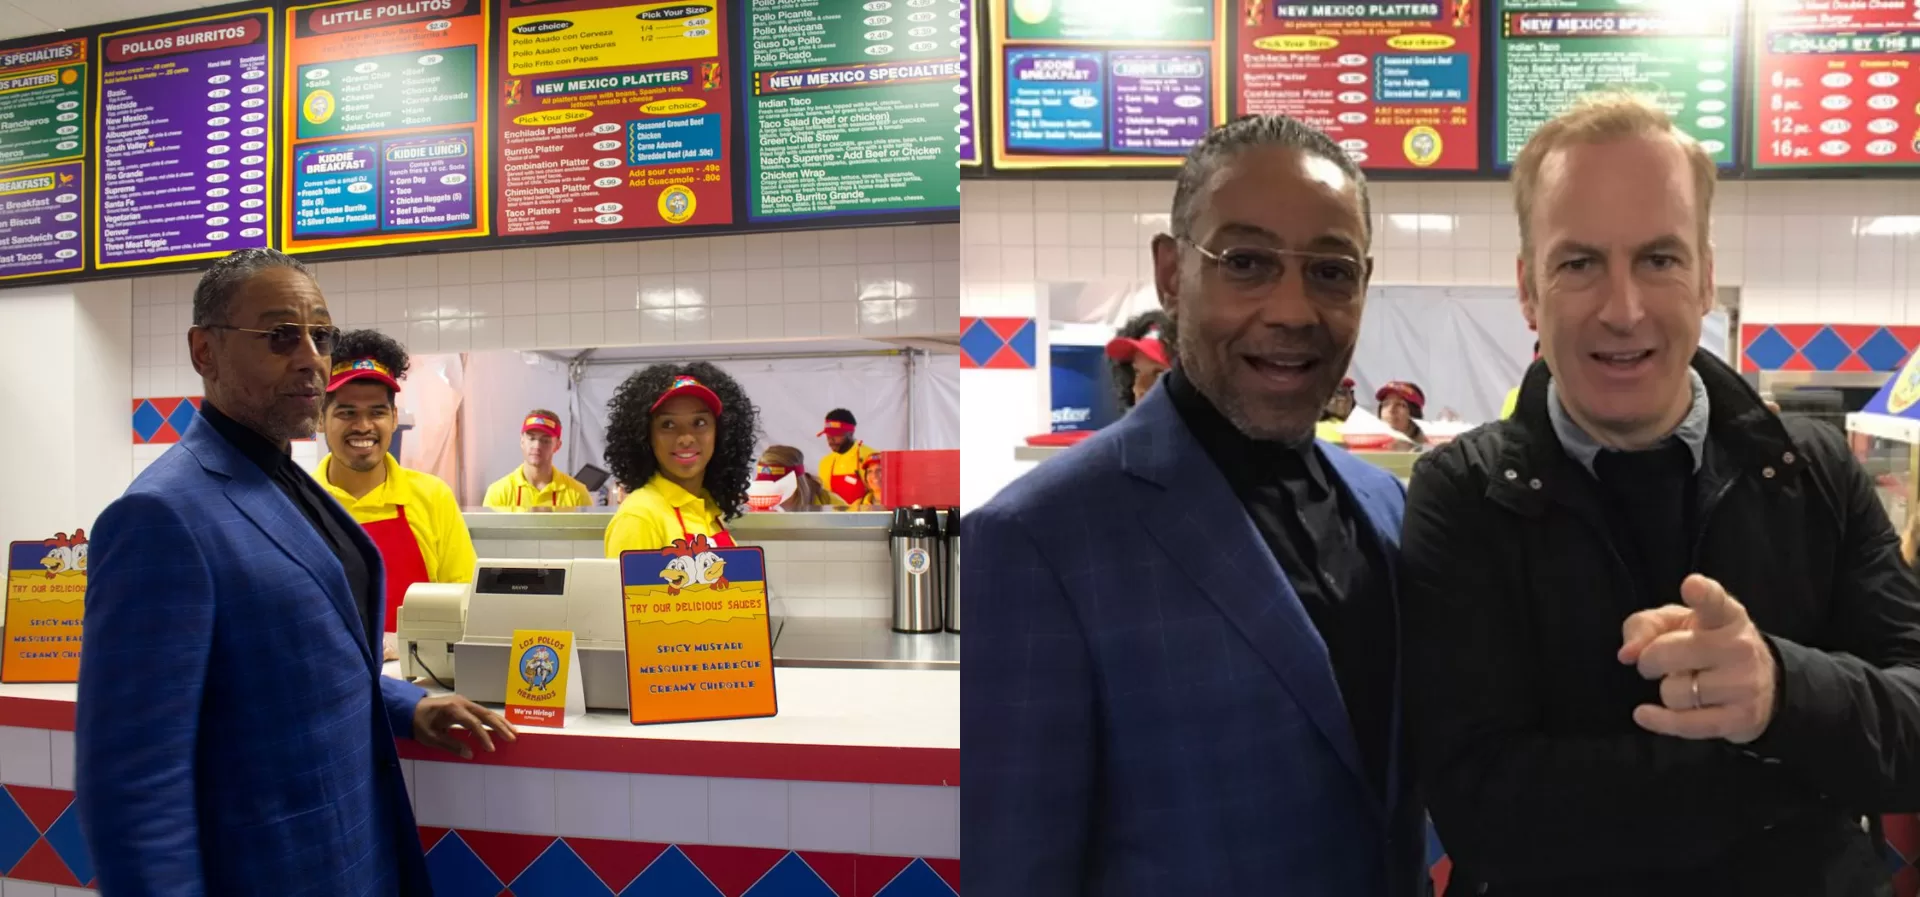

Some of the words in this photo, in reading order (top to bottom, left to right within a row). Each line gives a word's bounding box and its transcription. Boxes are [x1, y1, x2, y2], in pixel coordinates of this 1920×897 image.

[322, 9, 372, 26] LITTLE
[377, 0, 451, 18] POLLITOS
[664, 9, 683, 17] Your
[1277, 5, 1308, 16] NEW
[1312, 5, 1365, 16] MEXICO
[1369, 4, 1438, 16] PLATTERS
[753, 14, 776, 22] Pollo
[778, 10, 812, 19] Picante
[538, 23, 568, 32] choice:
[753, 28, 776, 36] Pollo
[778, 23, 823, 33] Mexicana
[1520, 19, 1553, 30] NEW
[1557, 19, 1615, 30] MEXICO
[122, 38, 172, 55] POLLOS
[177, 26, 245, 46] BURRITOS
[513, 38, 533, 46] Pollo
[535, 35, 560, 43] Asado
[580, 30, 613, 38] Cerveza
[1789, 38, 1847, 49] POLLOS
[1852, 38, 1872, 49] BY
[1877, 38, 1906, 48] THE
[535, 47, 560, 55] Asado
[580, 41, 616, 50] Verduras
[5, 46, 73, 65] SPECIALTIES
[535, 59, 554, 67] Frito
[574, 55, 598, 64] Papas
[779, 52, 811, 60] Picado
[12, 74, 56, 88] PLATTERS
[536, 83, 564, 94] NEW
[568, 77, 618, 91] MEXICO
[622, 71, 688, 85] PLATTERS
[770, 76, 802, 88] NEW
[807, 70, 865, 85] MEXICO
[107, 89, 126, 97] Basic
[106, 101, 137, 111] Westside
[759, 100, 787, 108] Indian
[1, 118, 50, 129] Rancheros
[123, 114, 148, 123] Mexico
[637, 121, 665, 130] Seasoned
[667, 119, 688, 128] Ground
[690, 118, 704, 126] Beef
[1772, 117, 1792, 133] 12
[106, 129, 149, 140] Albuquerque
[505, 129, 545, 138] Enchilada
[637, 132, 661, 140] Chicken
[760, 136, 787, 145] Green
[790, 134, 813, 143] Chile
[816, 133, 839, 141] Stew
[106, 144, 125, 152] South
[127, 143, 147, 151] Valley
[395, 148, 426, 159] KIDDIE
[429, 144, 460, 155] LUNCH
[505, 147, 533, 156] Burrito
[536, 145, 564, 153] Platter
[1772, 140, 1792, 156] 16
[318, 152, 353, 163] KIDDIE
[760, 156, 790, 164] Nacho
[793, 153, 834, 163] Supreme
[843, 150, 862, 159] Add
[866, 149, 887, 158] Beef
[902, 146, 941, 155] Chicken
[307, 160, 366, 174] BREAKFAST
[505, 160, 558, 171] Combination
[561, 159, 589, 167] Platter
[118, 170, 143, 179] Grande
[648, 168, 665, 176] sour
[668, 166, 693, 174] cream
[761, 171, 798, 180] Chicken
[800, 169, 825, 178] Wrap
[648, 176, 694, 185] Guacamole
[105, 186, 135, 195] Supreme
[505, 186, 560, 197] Chimichanga
[562, 184, 591, 192] Platter
[761, 194, 793, 203] Macho
[796, 192, 827, 201] Burrito
[829, 190, 864, 199] Grande
[6, 198, 50, 209] Breakfast
[105, 201, 124, 209] Santa
[397, 207, 411, 215] Beef
[528, 207, 560, 215] Platters
[10, 217, 41, 226] Biscuit
[105, 214, 141, 224] Vegetarian
[12, 233, 53, 244] Sandwich
[105, 229, 129, 237] Denver
[17, 253, 42, 261] Tacos
[12, 585, 27, 593] TRY
[32, 585, 46, 593] OUR
[50, 585, 86, 593] DELICIOU
[630, 604, 647, 614] TRY
[653, 603, 671, 612] OUR
[676, 601, 722, 612] DELICIOUS
[728, 599, 761, 609] SAUCES
[519, 636, 533, 650] LOS
[538, 636, 565, 650] POLLOS
[657, 644, 691, 653] SPICY
[694, 642, 743, 652] MUSTARD
[640, 664, 698, 674] MESQUITE
[702, 661, 761, 670] BARBECUE
[650, 683, 696, 693] CREAMY
[700, 681, 755, 691] CHIPOTLE
[517, 688, 556, 701] HERMANOS
[533, 709, 555, 717] Hiring!
